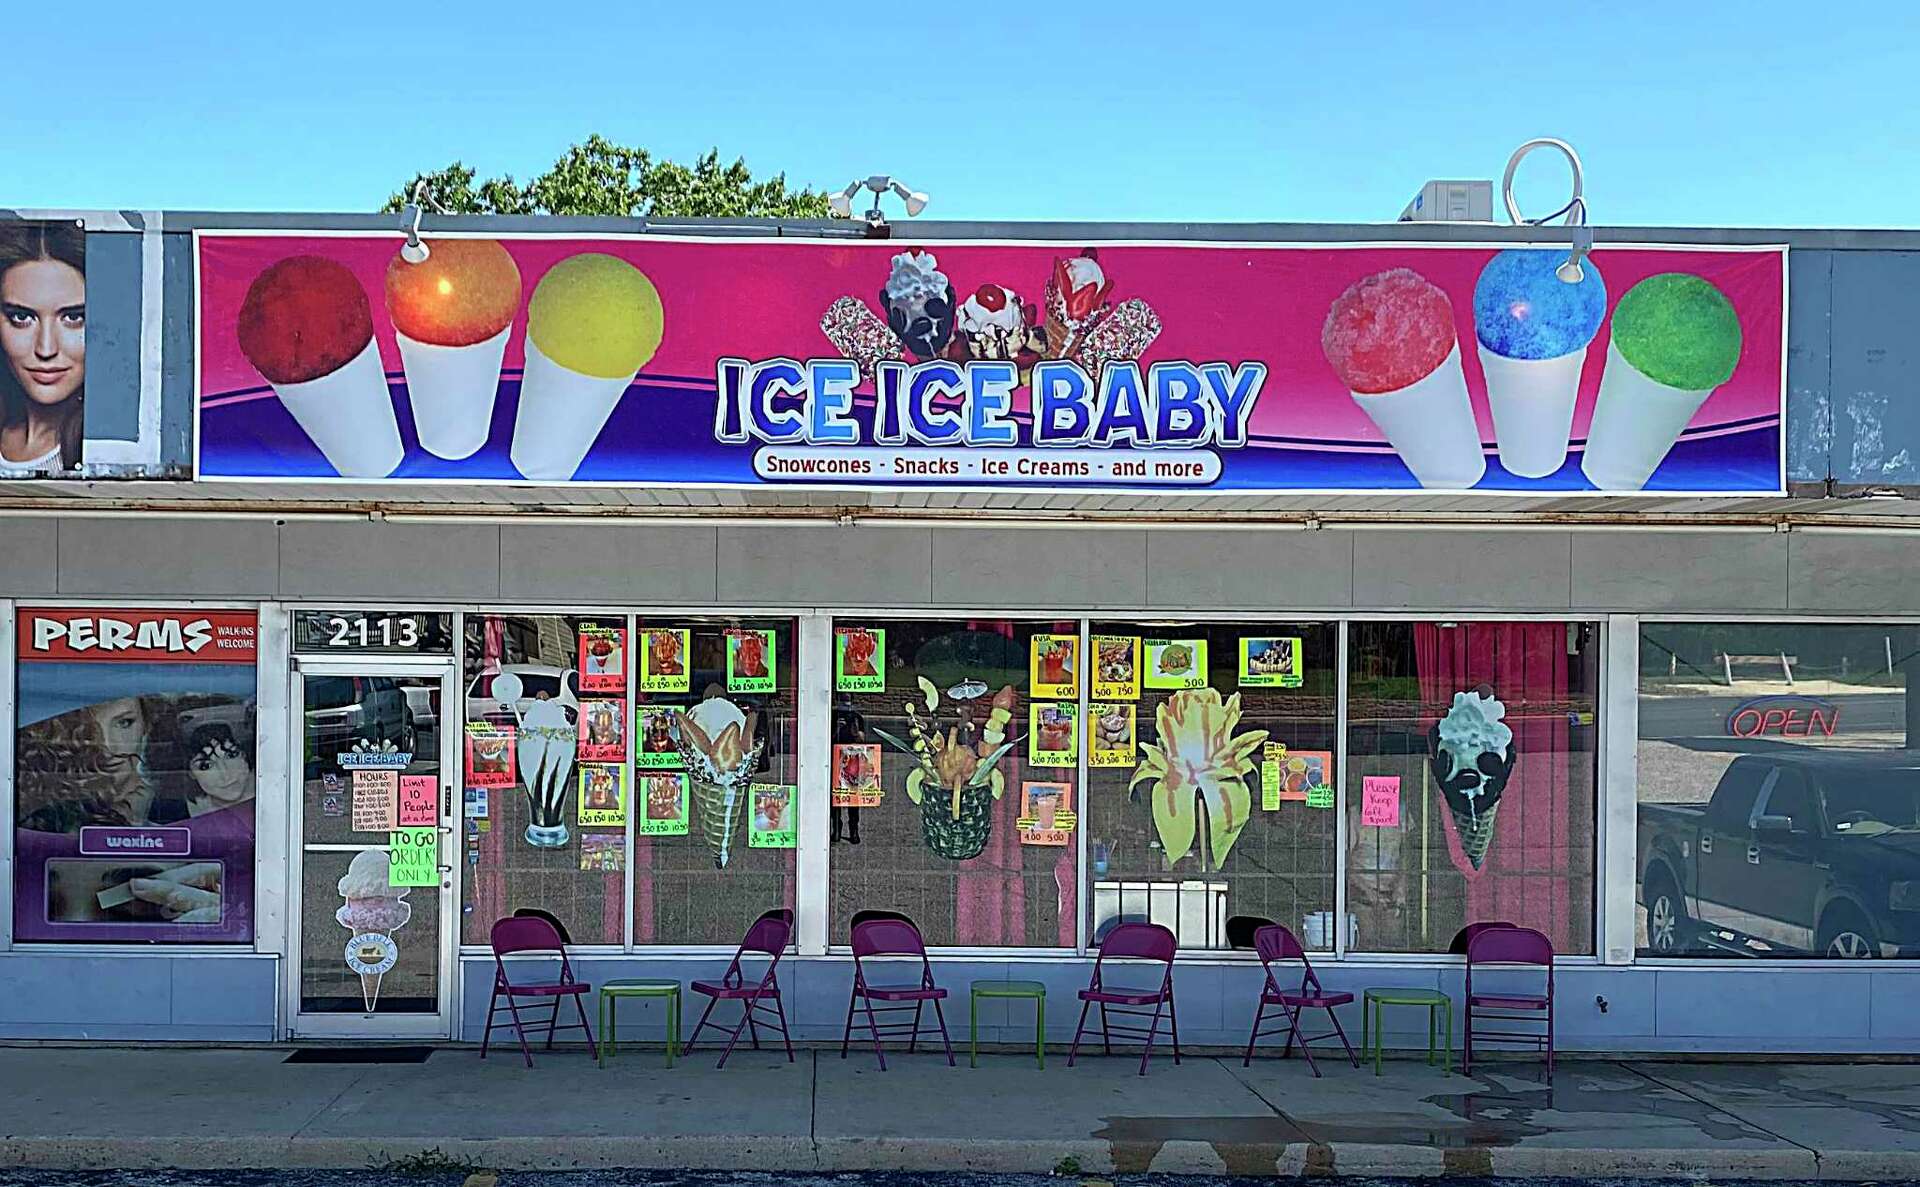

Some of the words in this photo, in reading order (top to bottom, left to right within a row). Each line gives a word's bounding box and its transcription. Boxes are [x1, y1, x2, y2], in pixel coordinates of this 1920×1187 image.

[714, 358, 863, 446] ICE
[874, 358, 1020, 447] ICE
[1031, 360, 1269, 448] BABY
[767, 455, 871, 473] Snowcones
[894, 457, 959, 474] Snacks
[981, 458, 1009, 475] Ice
[1017, 458, 1089, 476] Creams
[1112, 459, 1146, 477] and
[1155, 462, 1204, 477] more
[34, 617, 213, 652] PERMS
[216, 626, 254, 636] WALK-INS
[329, 618, 418, 647] 2113
[216, 639, 254, 649] WELCOME
[1732, 709, 1840, 737] OPEN
[337, 753, 357, 765] ICE
[359, 753, 380, 765] ICE
[380, 753, 412, 764] BABY
[360, 772, 389, 781] HOURS
[403, 779, 426, 787] Limit
[409, 790, 420, 799] 10
[404, 802, 434, 815] People
[391, 831, 410, 845] TO
[397, 868, 430, 882] ONLY
[351, 935, 369, 949] BLUE
[363, 958, 392, 973] CREAM
